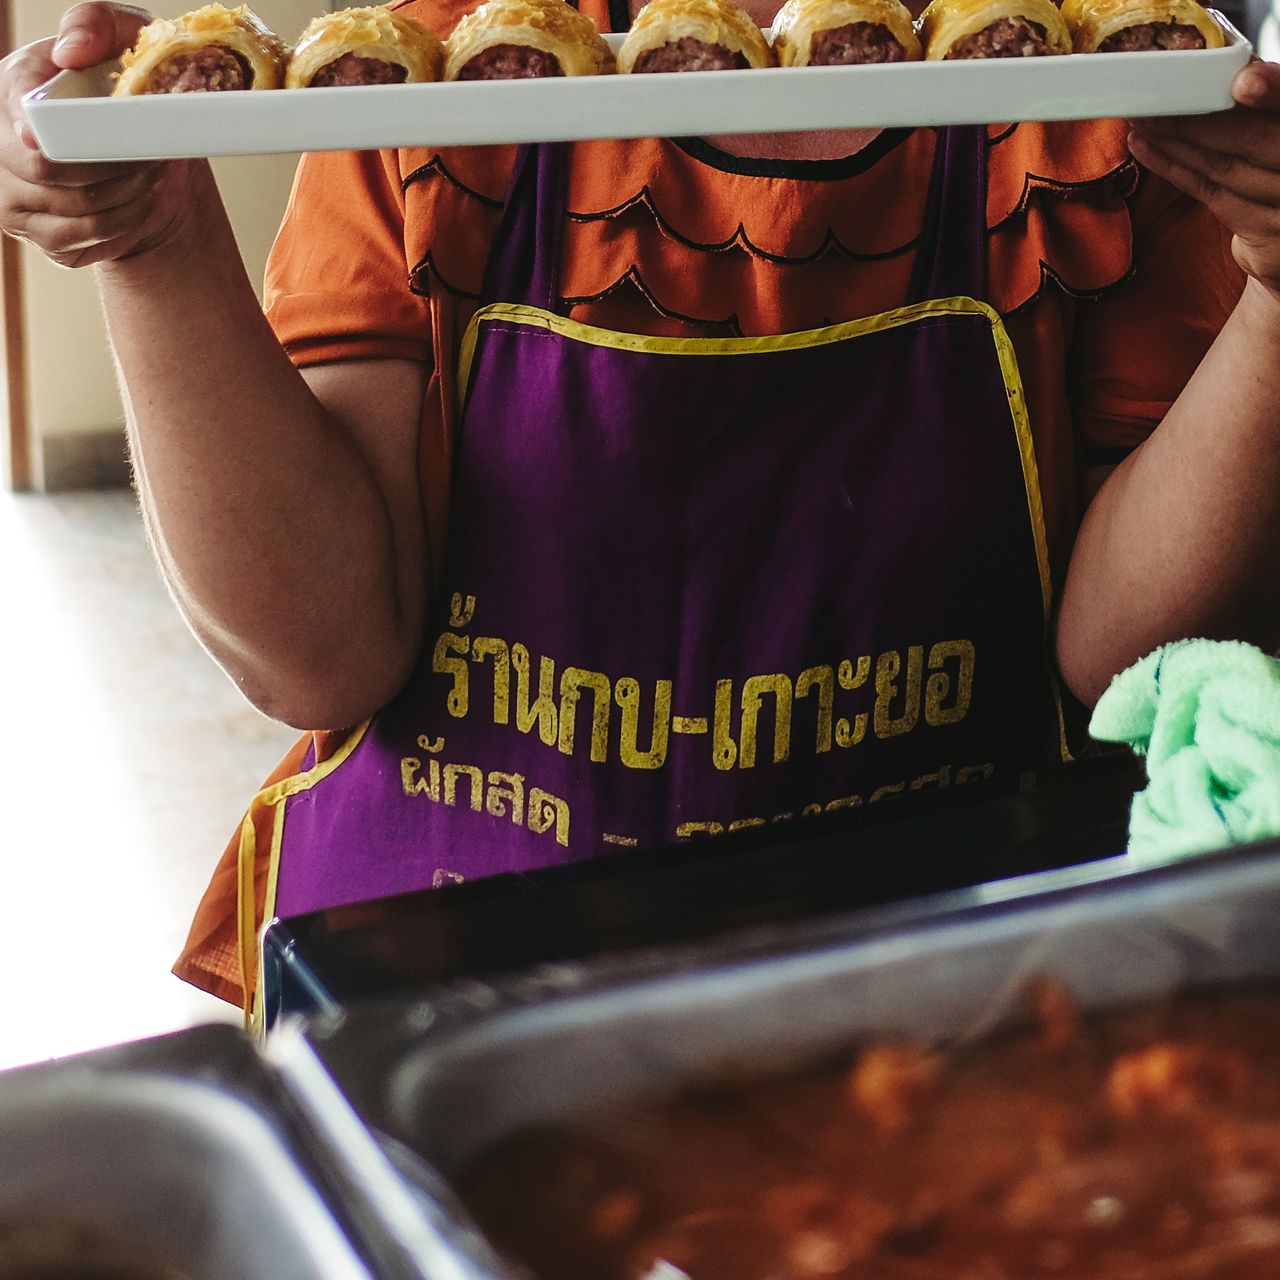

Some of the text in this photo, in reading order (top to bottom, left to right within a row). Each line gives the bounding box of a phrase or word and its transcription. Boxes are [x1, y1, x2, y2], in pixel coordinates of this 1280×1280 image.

[432, 591, 976, 771] ร้านกบ-เกาะยอ
[400, 734, 571, 848] ผักสด
